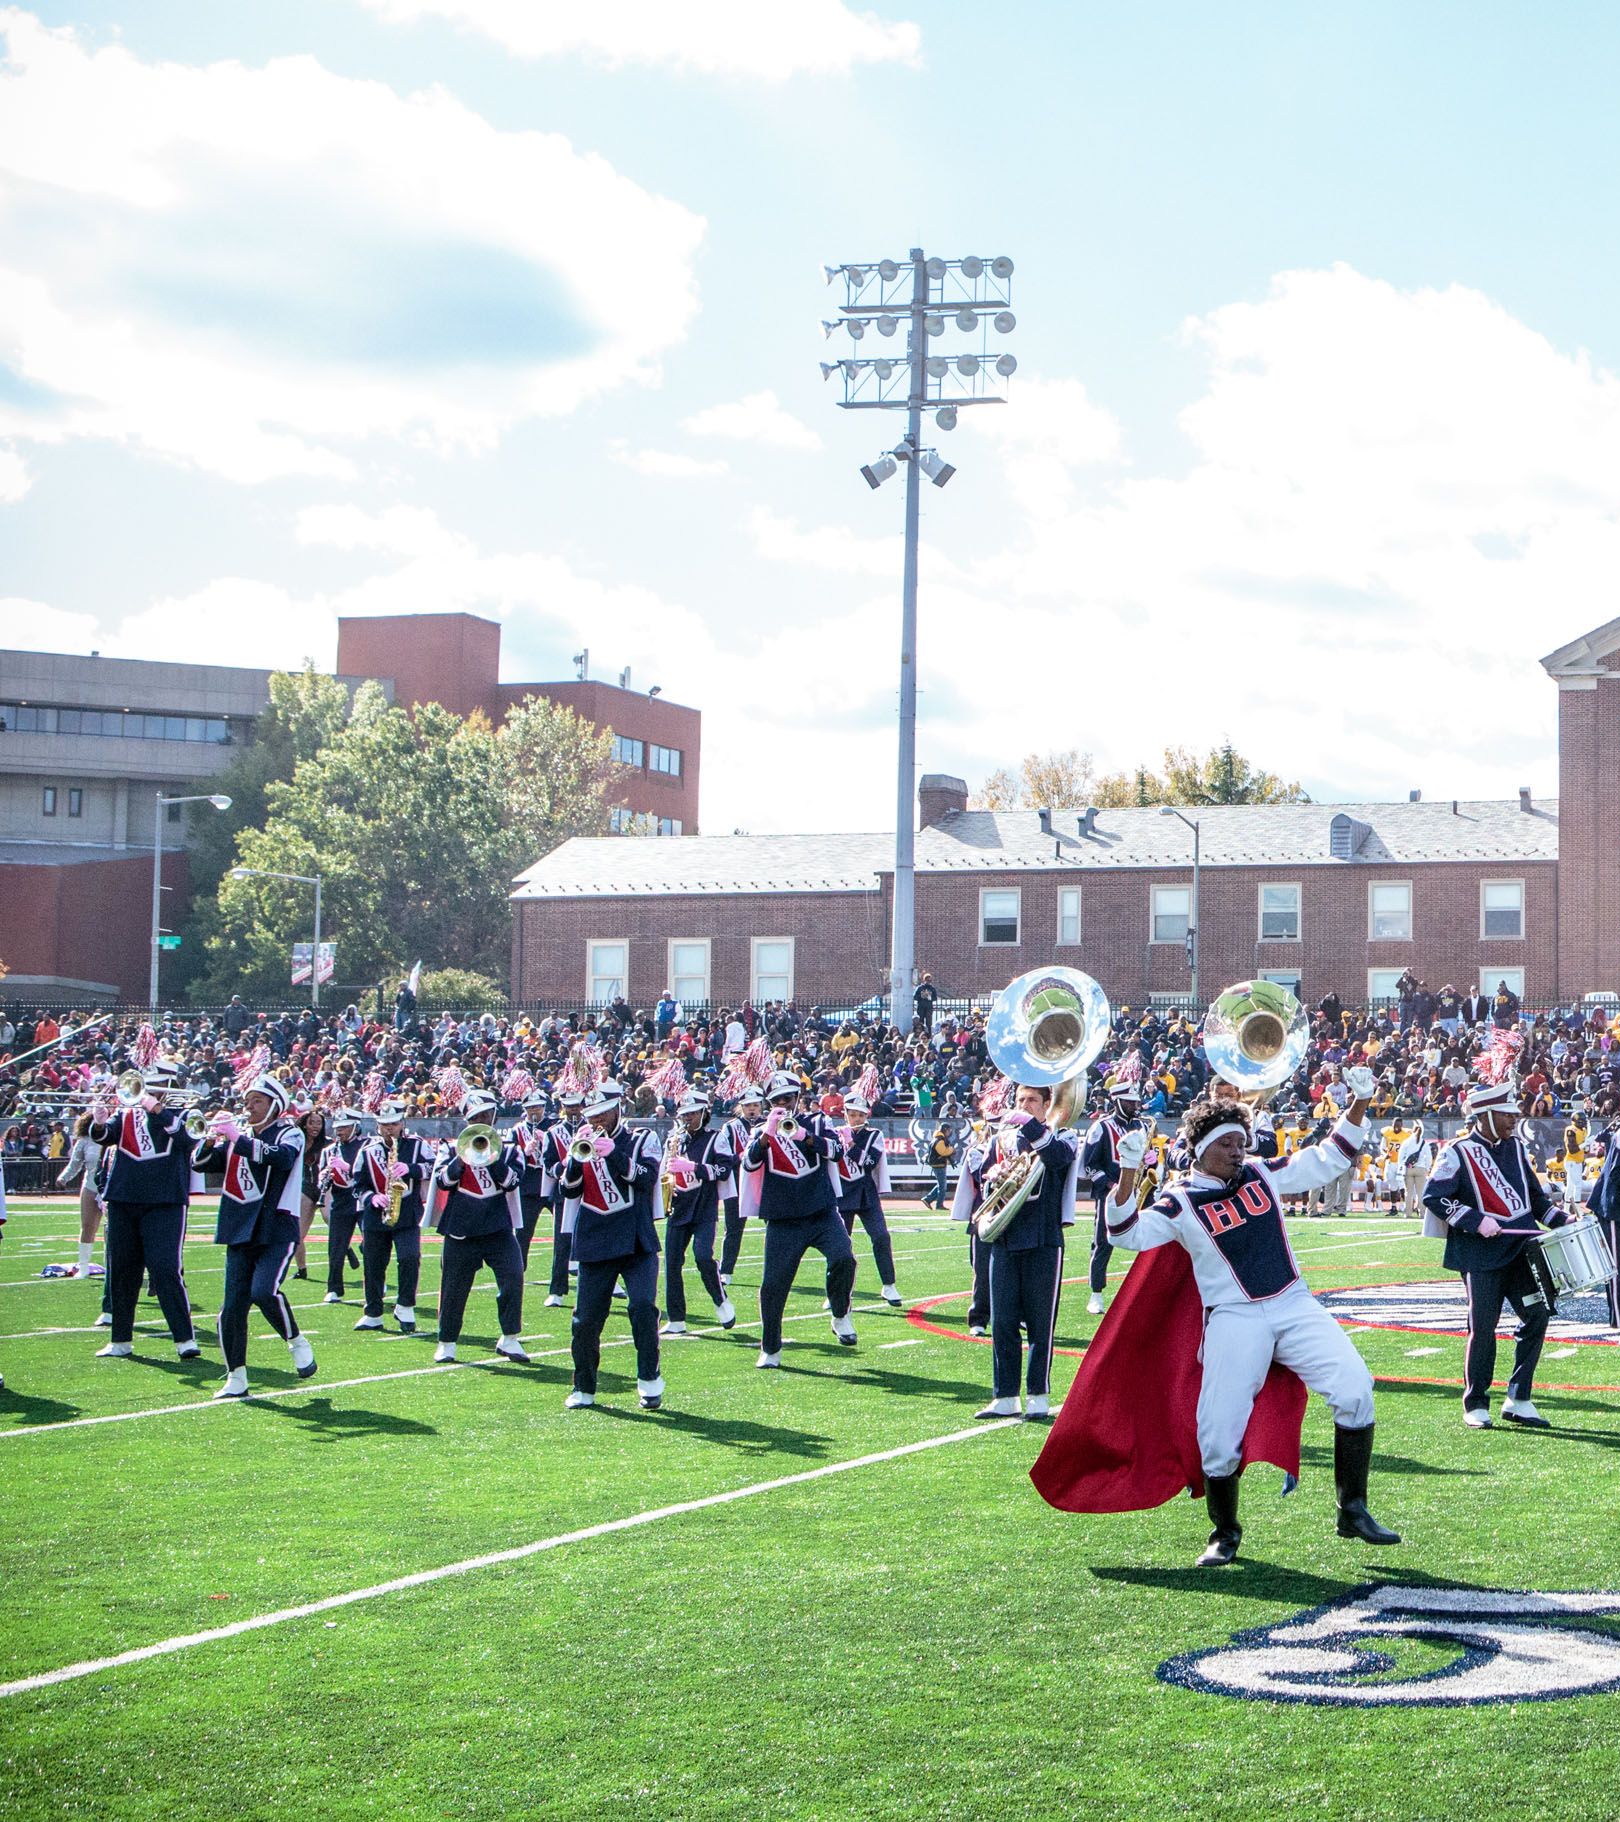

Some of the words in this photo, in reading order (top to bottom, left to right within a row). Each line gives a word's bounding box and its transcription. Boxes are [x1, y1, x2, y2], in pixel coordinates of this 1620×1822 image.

[776, 1135, 806, 1169] WARD
[240, 1157, 254, 1192] ARD
[592, 1160, 619, 1204] WARD
[1472, 1145, 1522, 1212] HOWARD
[1199, 1180, 1272, 1237] HU
